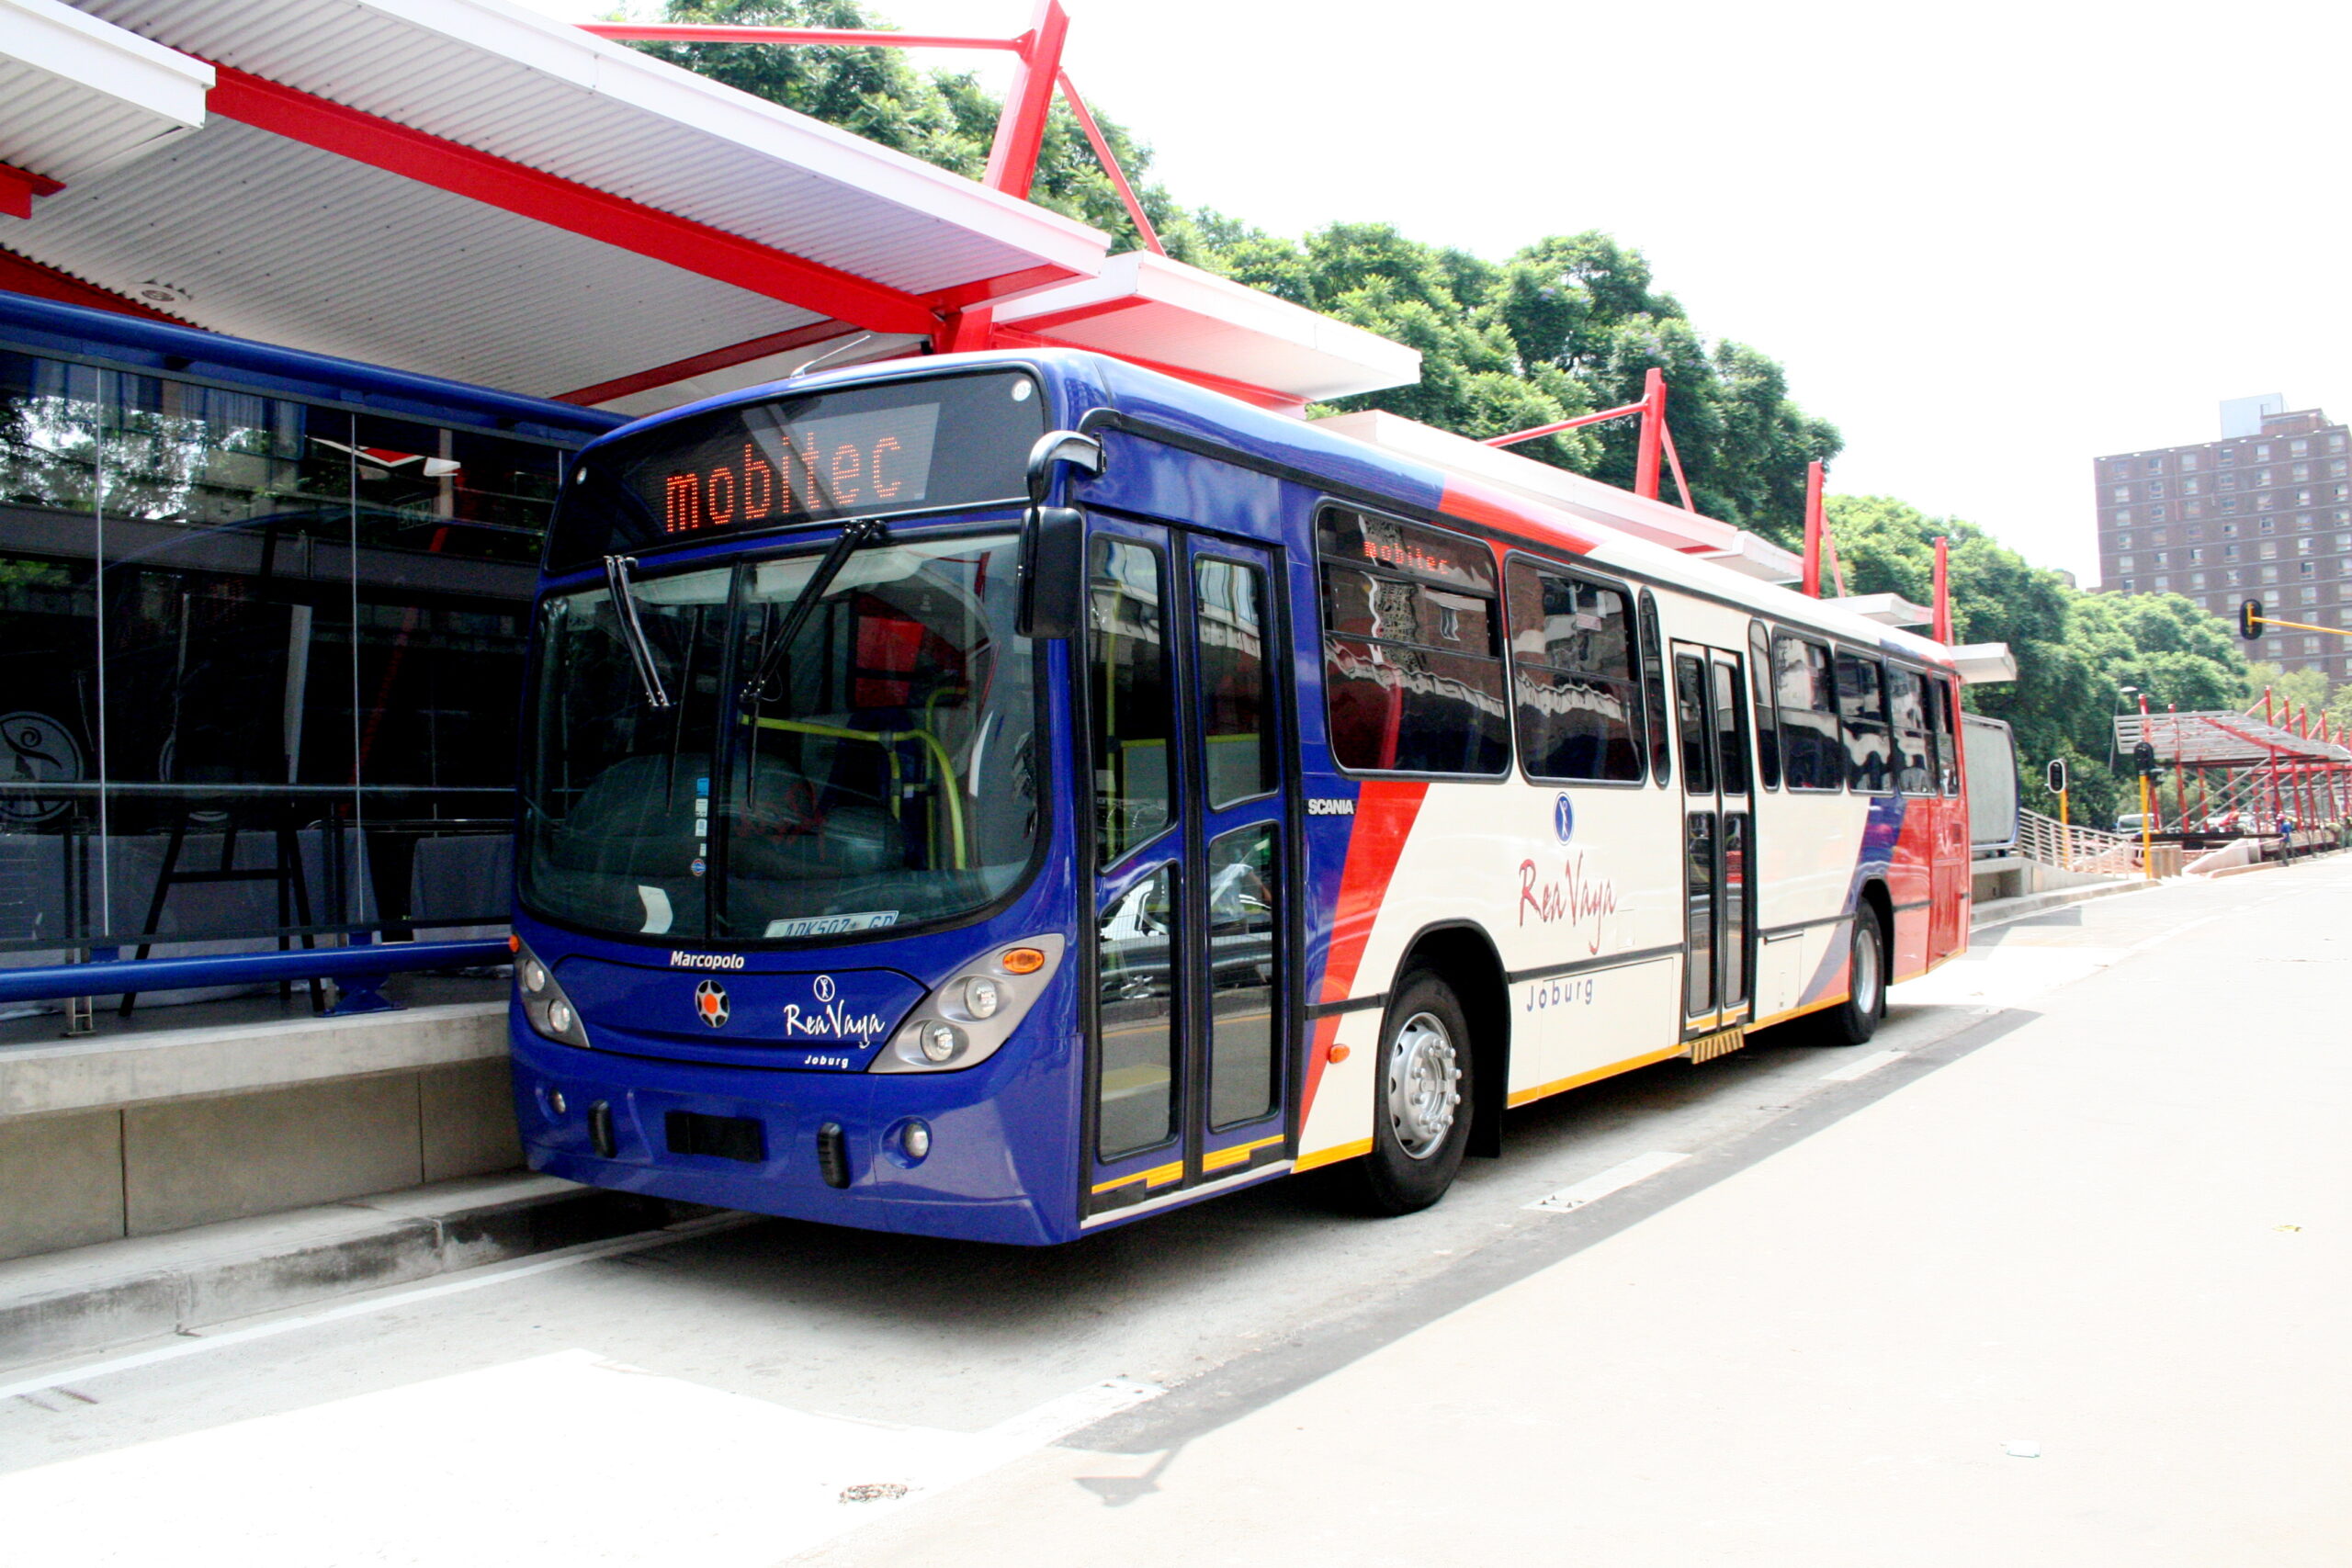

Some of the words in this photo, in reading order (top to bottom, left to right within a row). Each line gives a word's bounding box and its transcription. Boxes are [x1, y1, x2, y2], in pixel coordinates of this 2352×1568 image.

[666, 432, 901, 534] mobitec
[1308, 798, 1355, 815] SCANIA
[670, 951, 745, 970] Marcopolo
[1526, 978, 1593, 1012] Joburg
[804, 1055, 849, 1069] Joburg
